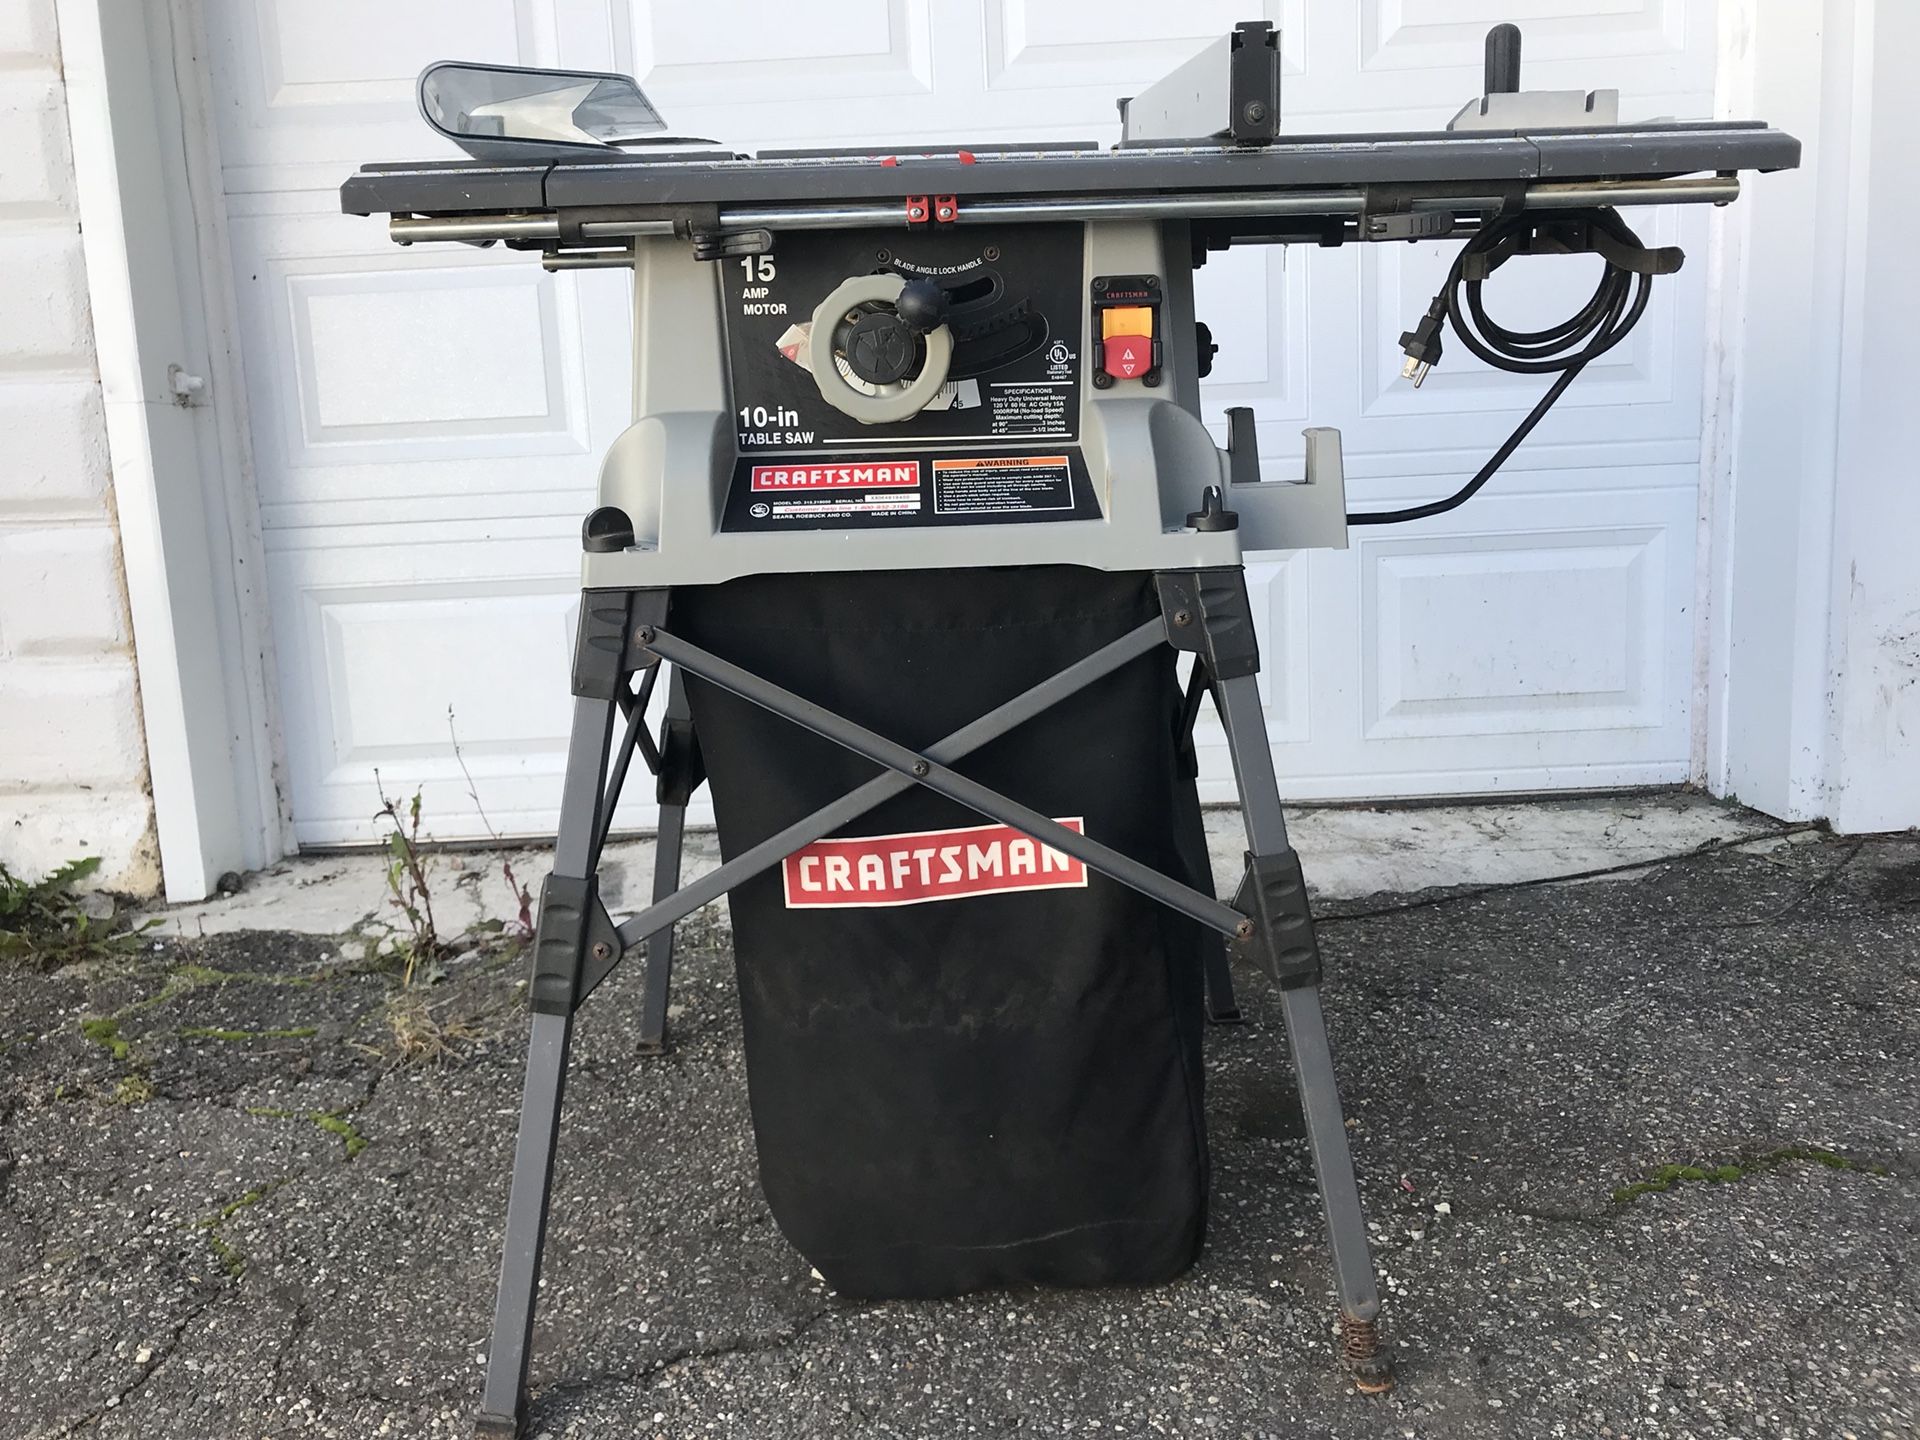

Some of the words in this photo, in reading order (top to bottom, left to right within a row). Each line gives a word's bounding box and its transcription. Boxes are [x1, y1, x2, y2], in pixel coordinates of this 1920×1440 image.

[741, 255, 775, 282] 15
[894, 259, 914, 271] BLADE
[957, 258, 982, 272] HANDLE
[743, 288, 769, 298] AMP
[744, 304, 787, 315] MOTOR
[740, 406, 798, 427] 10-in
[739, 432, 781, 444] TABLE
[785, 432, 814, 444] SAW
[760, 467, 911, 485] CRAFTSMAN
[799, 838, 1070, 892] CRAFTSMAN
